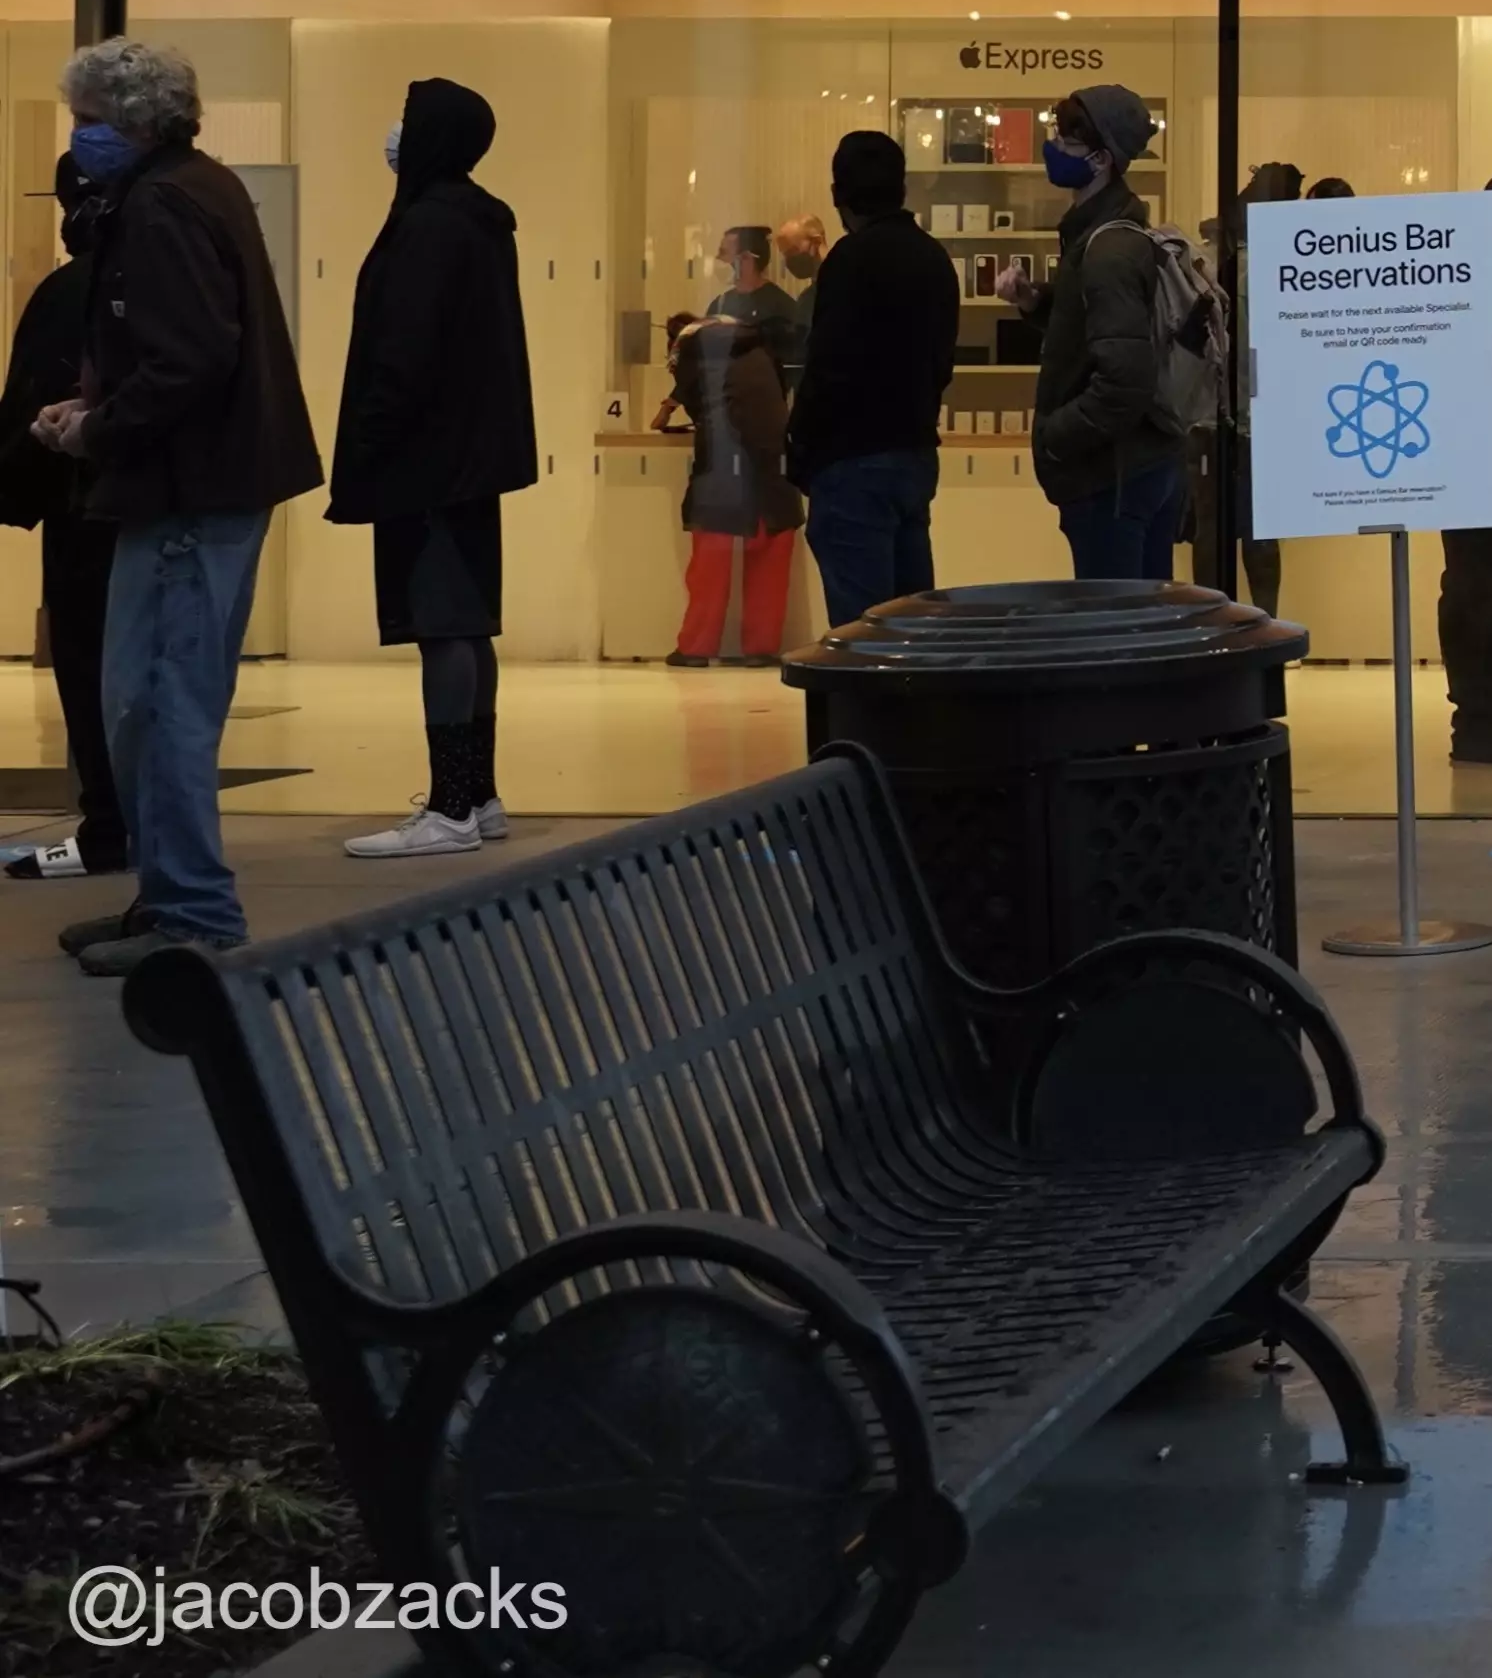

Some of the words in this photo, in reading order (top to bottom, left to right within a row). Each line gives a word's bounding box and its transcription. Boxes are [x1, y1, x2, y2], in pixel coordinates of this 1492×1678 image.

[986, 42, 1103, 75] Express
[1294, 226, 1397, 256] Genius
[1405, 223, 1456, 251] Bar
[1279, 258, 1471, 292] Reservations
[1278, 311, 1309, 320] Please
[1311, 310, 1329, 319] wait
[1331, 309, 1344, 317] for
[1345, 308, 1360, 317] the
[1362, 307, 1382, 316] next
[1384, 305, 1424, 315] available
[1301, 328, 1314, 338] Be
[1315, 329, 1335, 337] sure
[1336, 327, 1346, 336] to
[1347, 326, 1370, 335] have
[1371, 326, 1391, 336] your
[1393, 322, 1452, 333] confirmation
[1323, 339, 1348, 349] email
[1349, 340, 1359, 348] or
[1360, 337, 1375, 347] QR
[1377, 336, 1399, 346] code
[606, 400, 622, 418] 4
